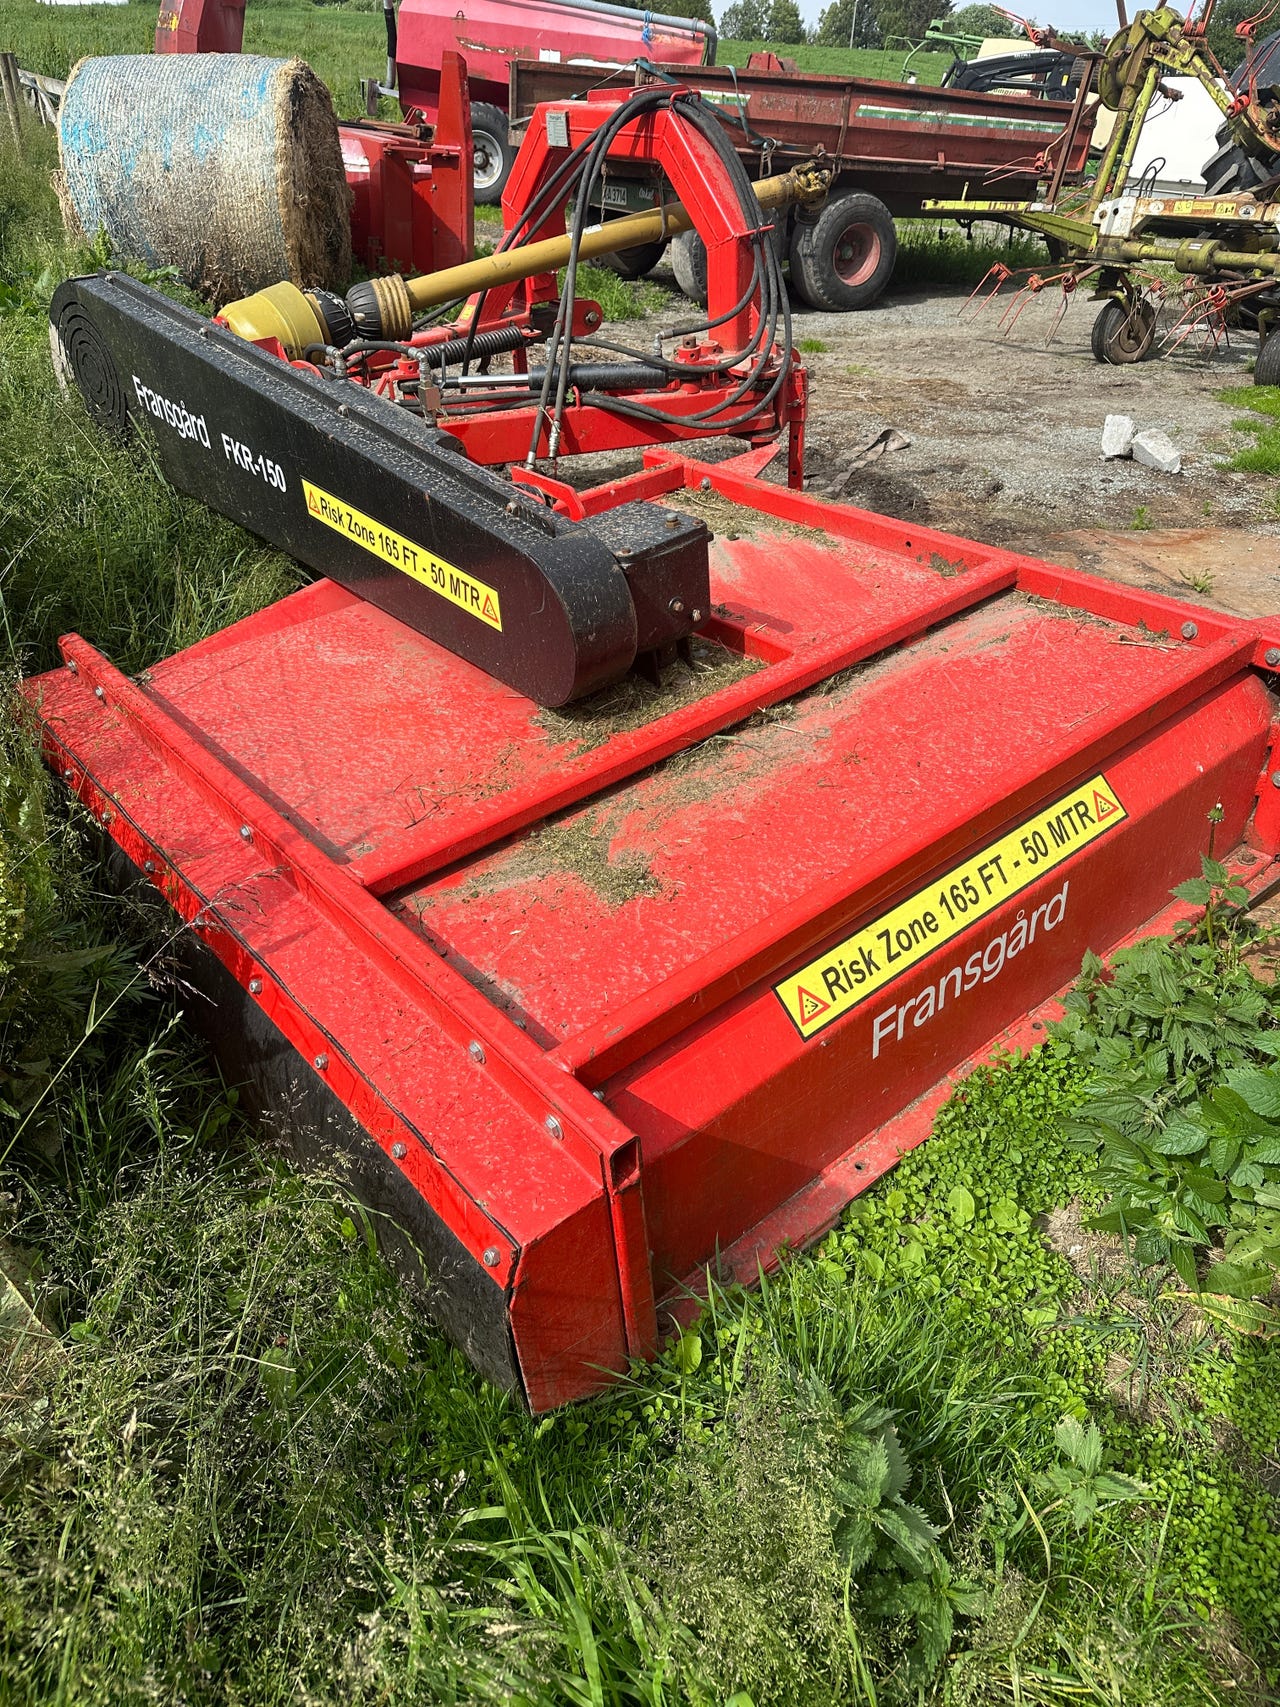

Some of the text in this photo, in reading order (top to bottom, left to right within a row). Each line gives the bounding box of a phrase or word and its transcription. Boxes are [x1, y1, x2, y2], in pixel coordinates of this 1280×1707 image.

[132, 374, 287, 493] Fransgård FKR-150
[320, 496, 345, 529] Risk
[346, 512, 376, 547] Zone
[378, 532, 400, 561] 165
[402, 545, 418, 572] FT
[430, 562, 446, 589] 50
[450, 573, 481, 611] MTR
[821, 945, 881, 1002] Risk
[876, 909, 939, 962] Zone
[939, 875, 980, 921] 165
[976, 854, 1009, 895] FT
[1020, 830, 1049, 864] 50
[1046, 800, 1096, 849] MTR
[872, 881, 1070, 1059] Fransgård
